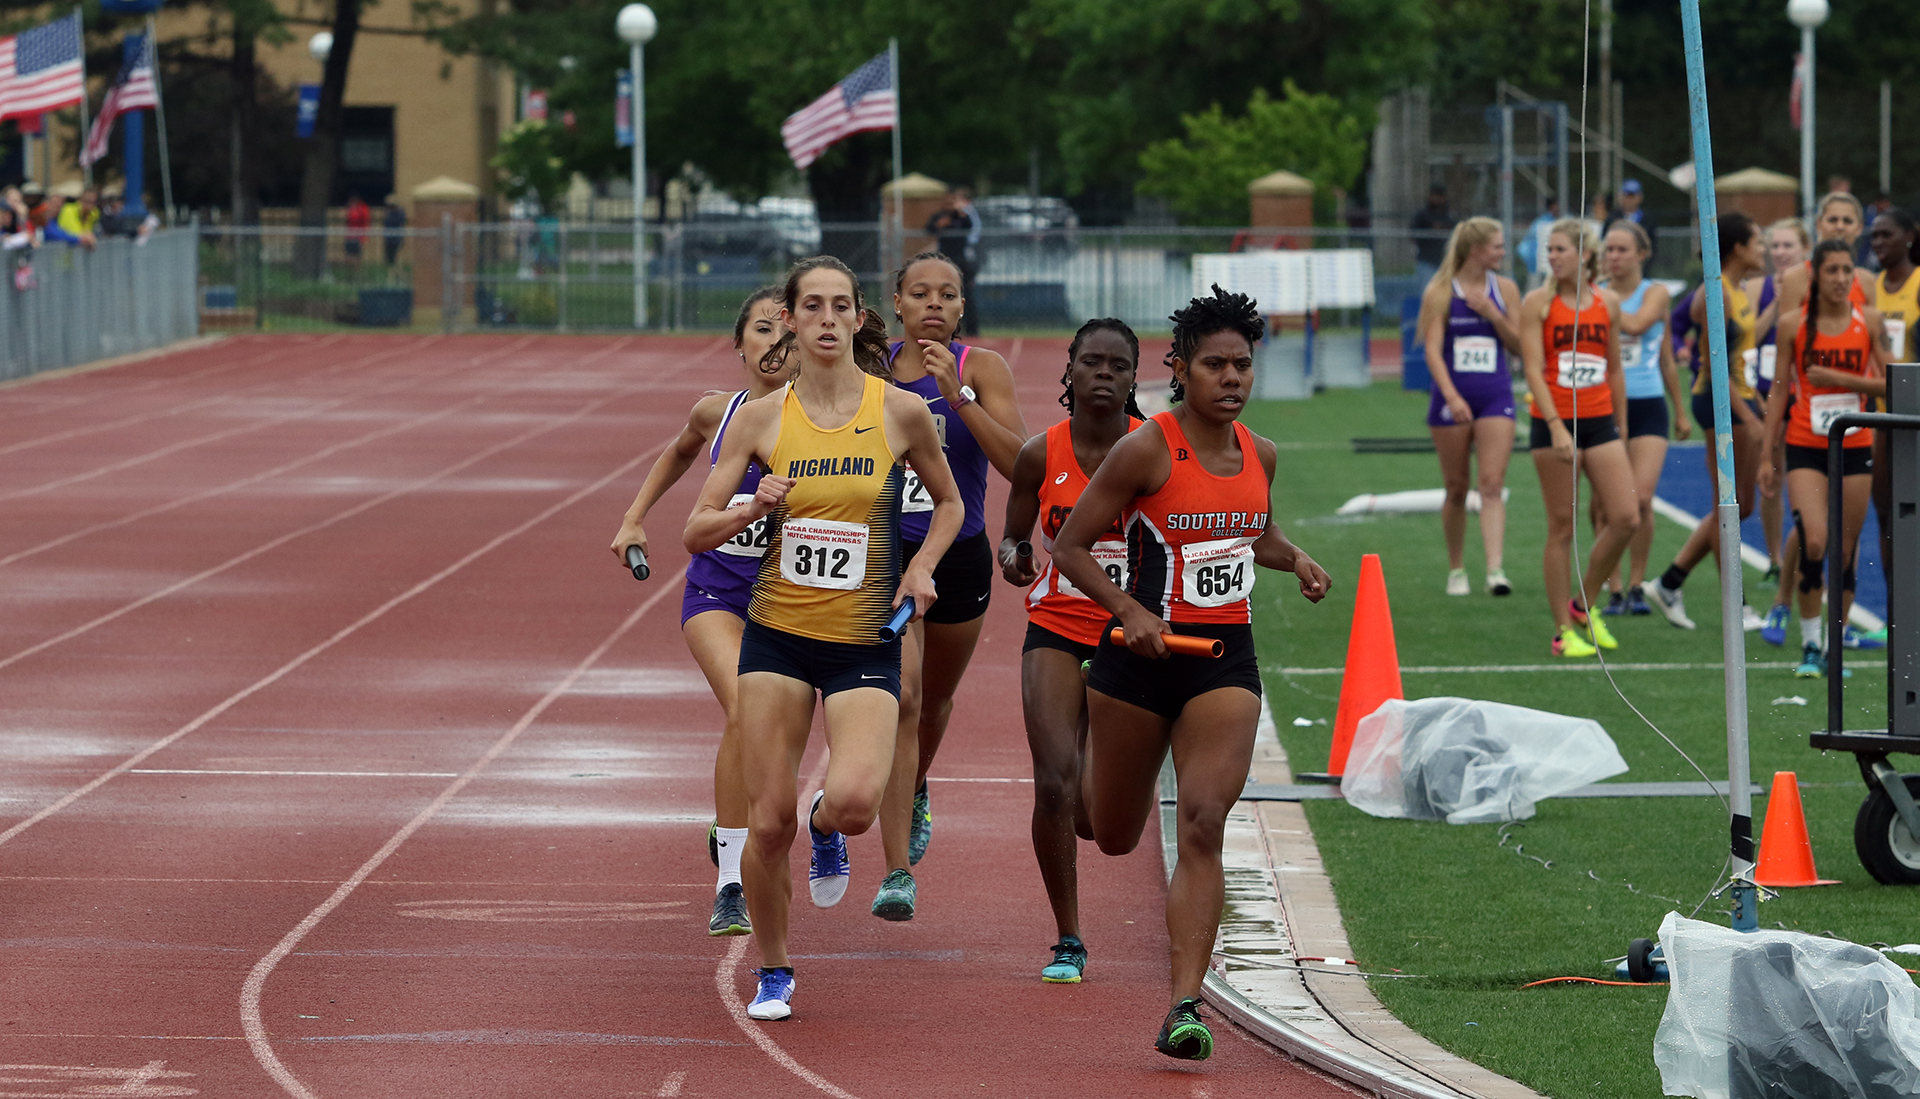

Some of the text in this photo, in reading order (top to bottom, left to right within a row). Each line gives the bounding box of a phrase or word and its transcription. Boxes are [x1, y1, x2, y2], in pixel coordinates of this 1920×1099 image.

[788, 457, 875, 479] HIGHLAND
[784, 524, 867, 538] NJCAA CHAMPIONSHIPS
[1167, 512, 1227, 530] SOUTH
[726, 520, 769, 548] 52
[787, 532, 830, 542] HUTCHINSON
[1211, 529, 1244, 537] COLLEGE
[795, 544, 850, 579] 312
[1196, 561, 1245, 597] 654
